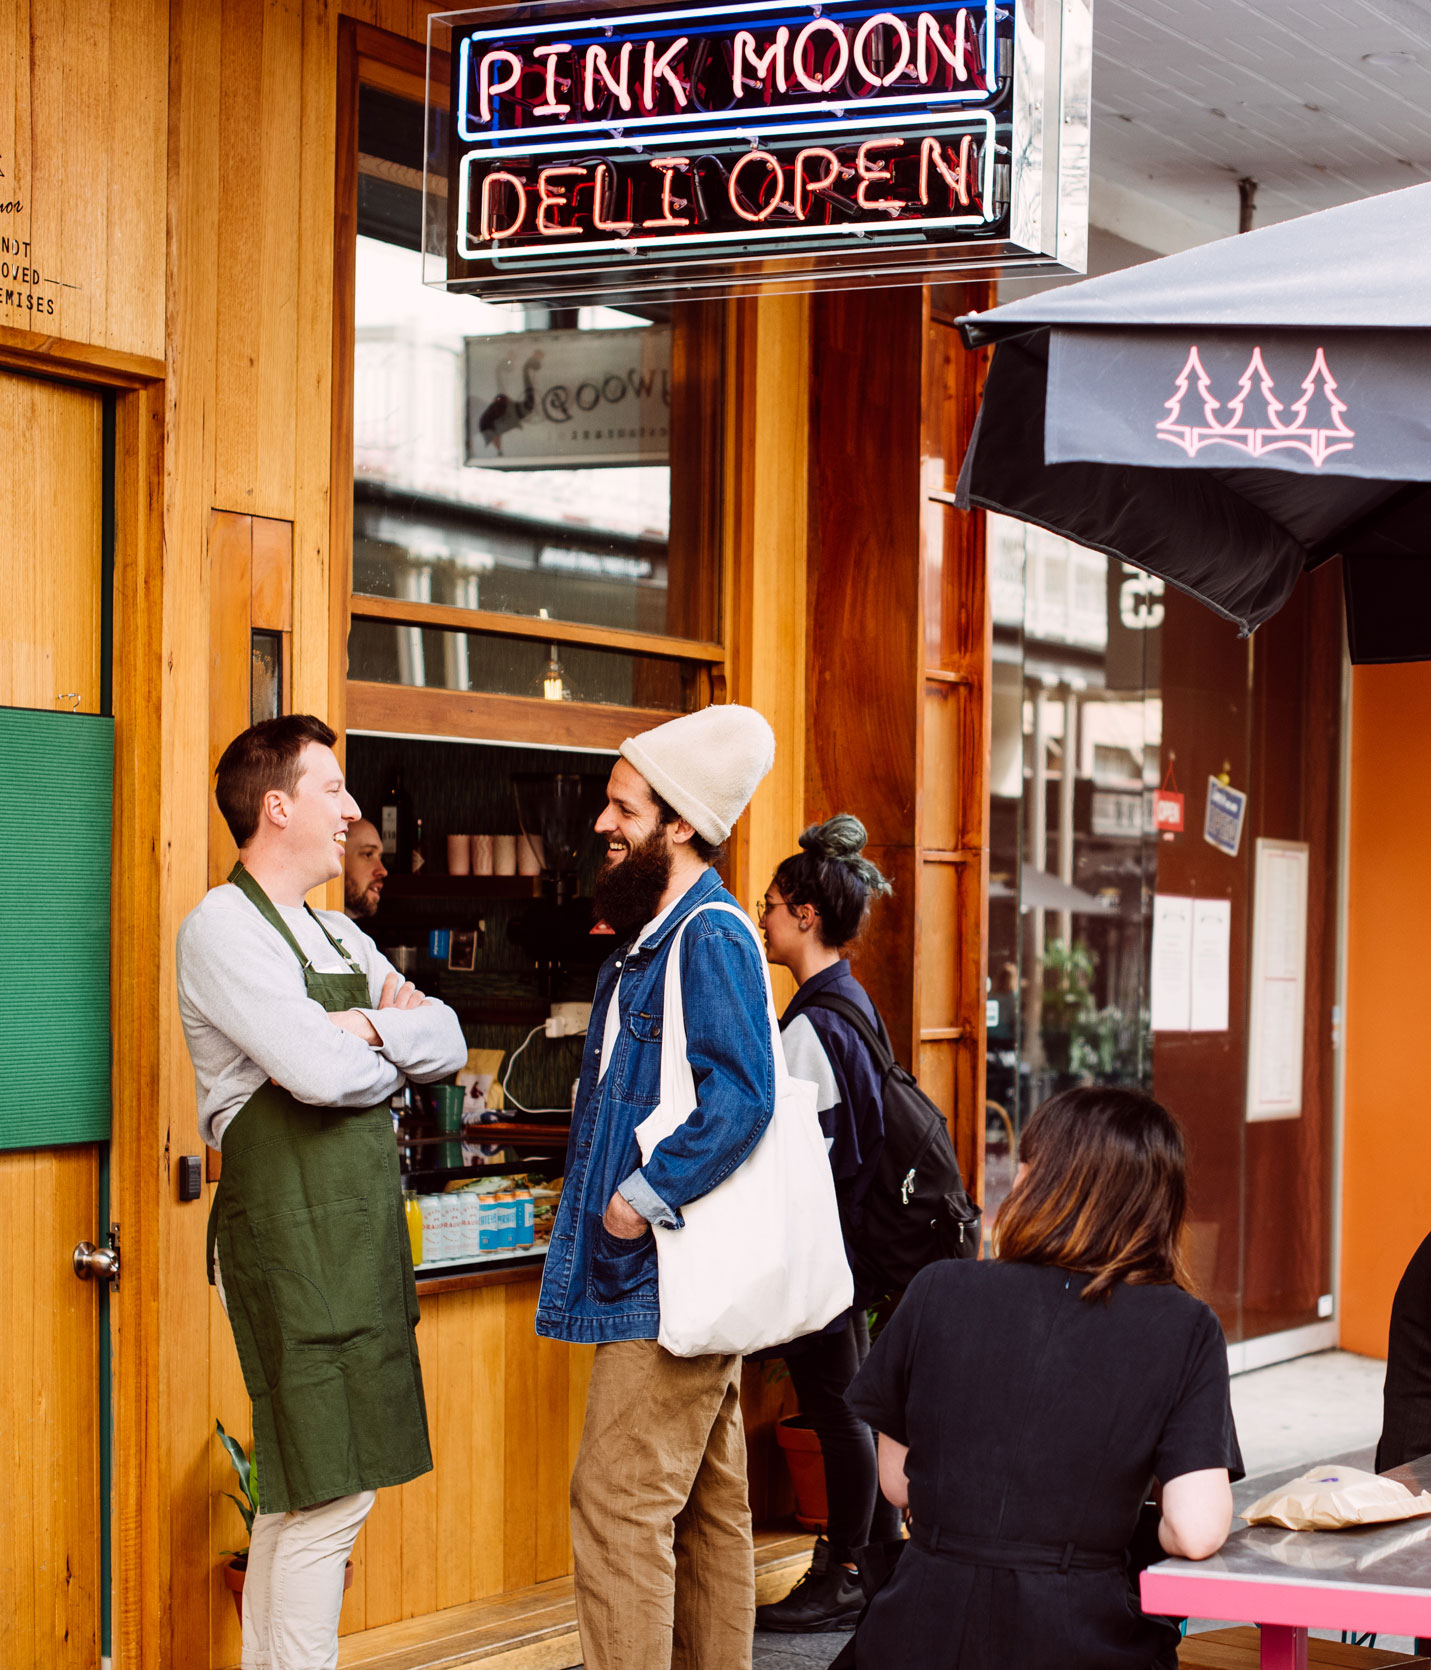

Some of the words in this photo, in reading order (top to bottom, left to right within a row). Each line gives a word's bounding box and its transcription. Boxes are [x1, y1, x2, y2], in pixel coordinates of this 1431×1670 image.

[479, 36, 689, 123] PINK
[732, 7, 969, 99] MOON
[480, 157, 690, 241] DELI
[728, 134, 973, 222] OPEN
